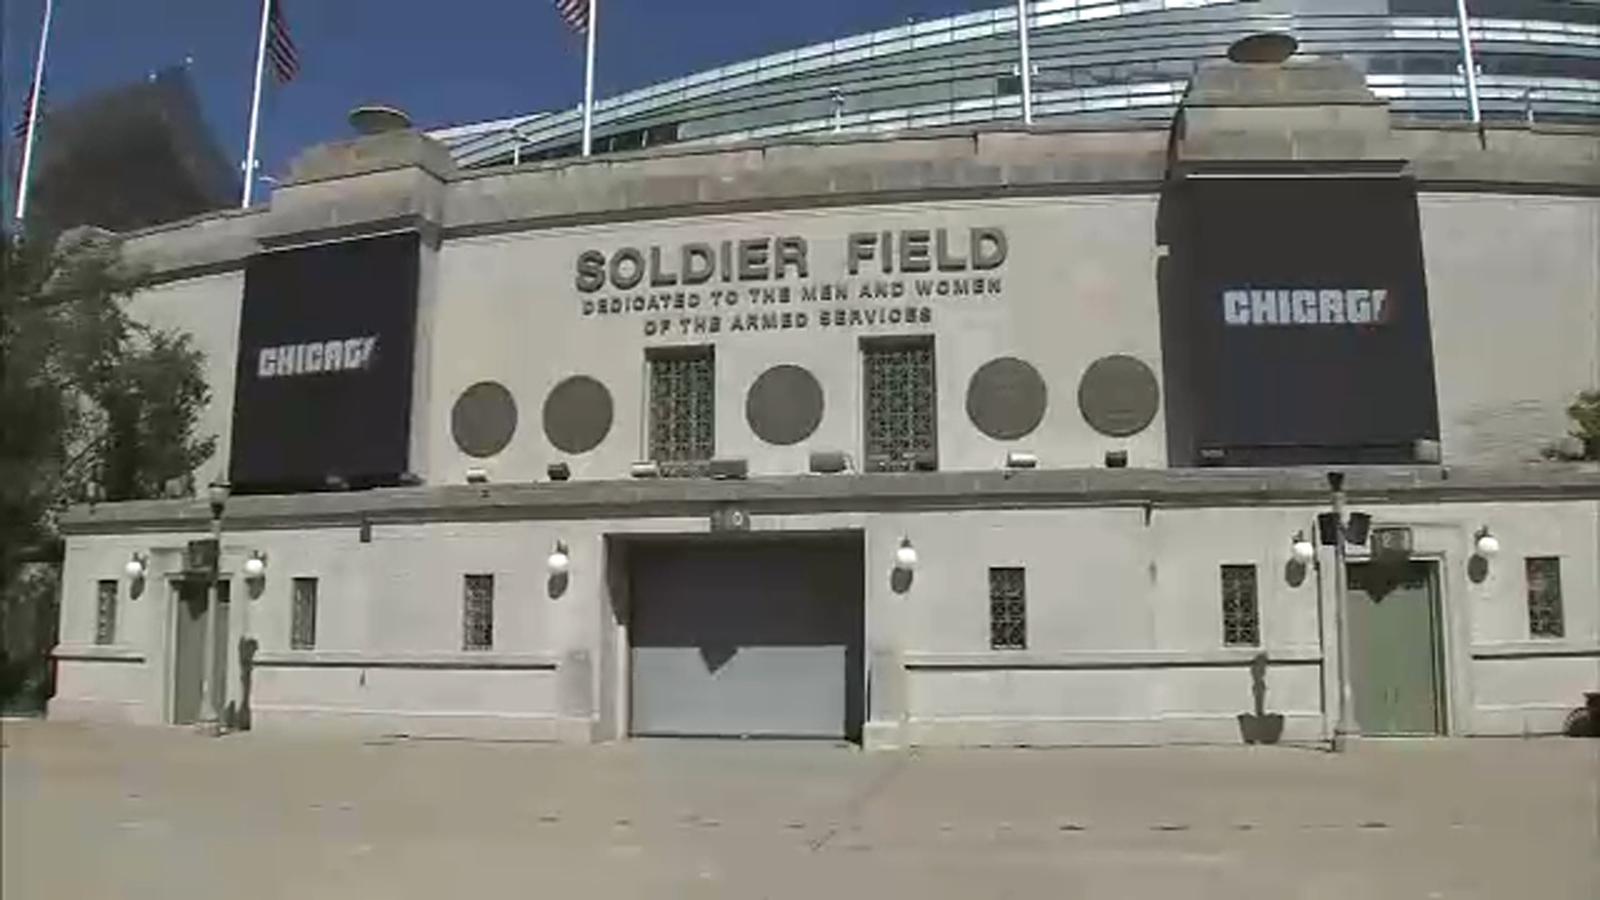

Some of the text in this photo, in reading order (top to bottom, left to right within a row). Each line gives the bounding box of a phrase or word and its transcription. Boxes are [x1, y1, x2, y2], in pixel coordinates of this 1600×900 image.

[576, 227, 1009, 293] SOLDIER FIELD
[582, 278, 1002, 315] DEDICATED TO THE MEN AND WOMEN
[643, 306, 932, 336] OF THE ARMED SERVICES
